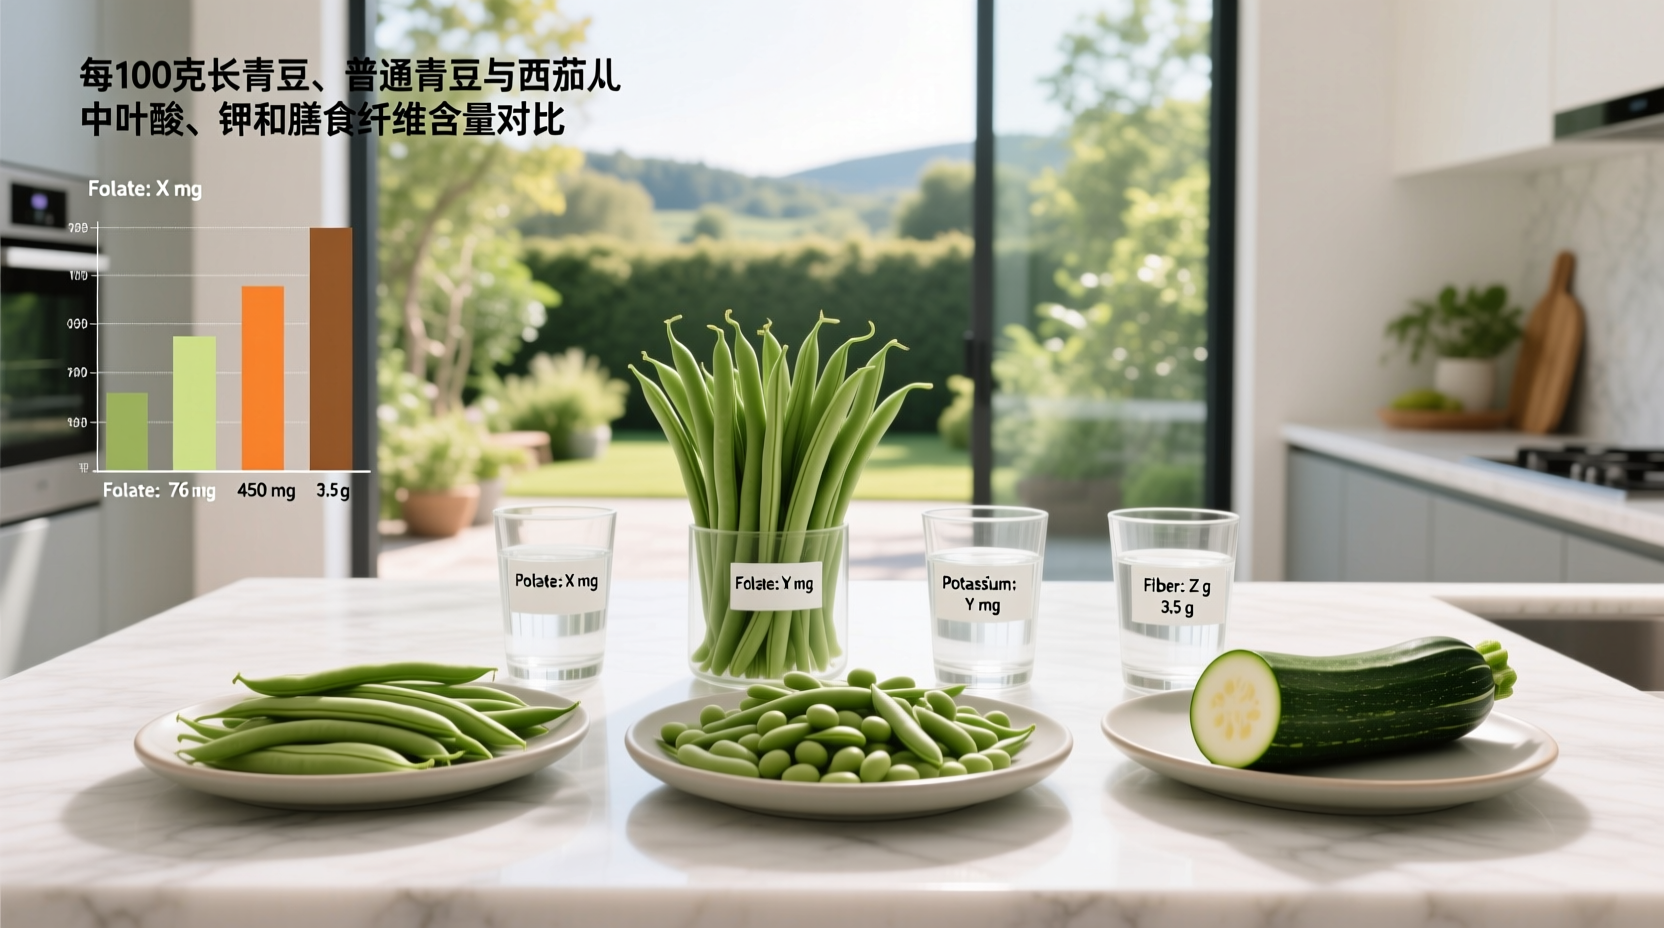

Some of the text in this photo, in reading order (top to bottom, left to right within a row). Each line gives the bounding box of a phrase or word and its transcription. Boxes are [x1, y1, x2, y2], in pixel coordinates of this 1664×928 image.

[565, 573, 575, 588] X
[577, 576, 598, 592] mg
[781, 575, 792, 590] Y
[794, 579, 814, 594] mg
[942, 575, 1017, 591] Potassium:
[1144, 577, 1211, 597] Fiber: Z g
[965, 597, 1001, 616] Y mg
[1161, 600, 1194, 618] 3.5 g
